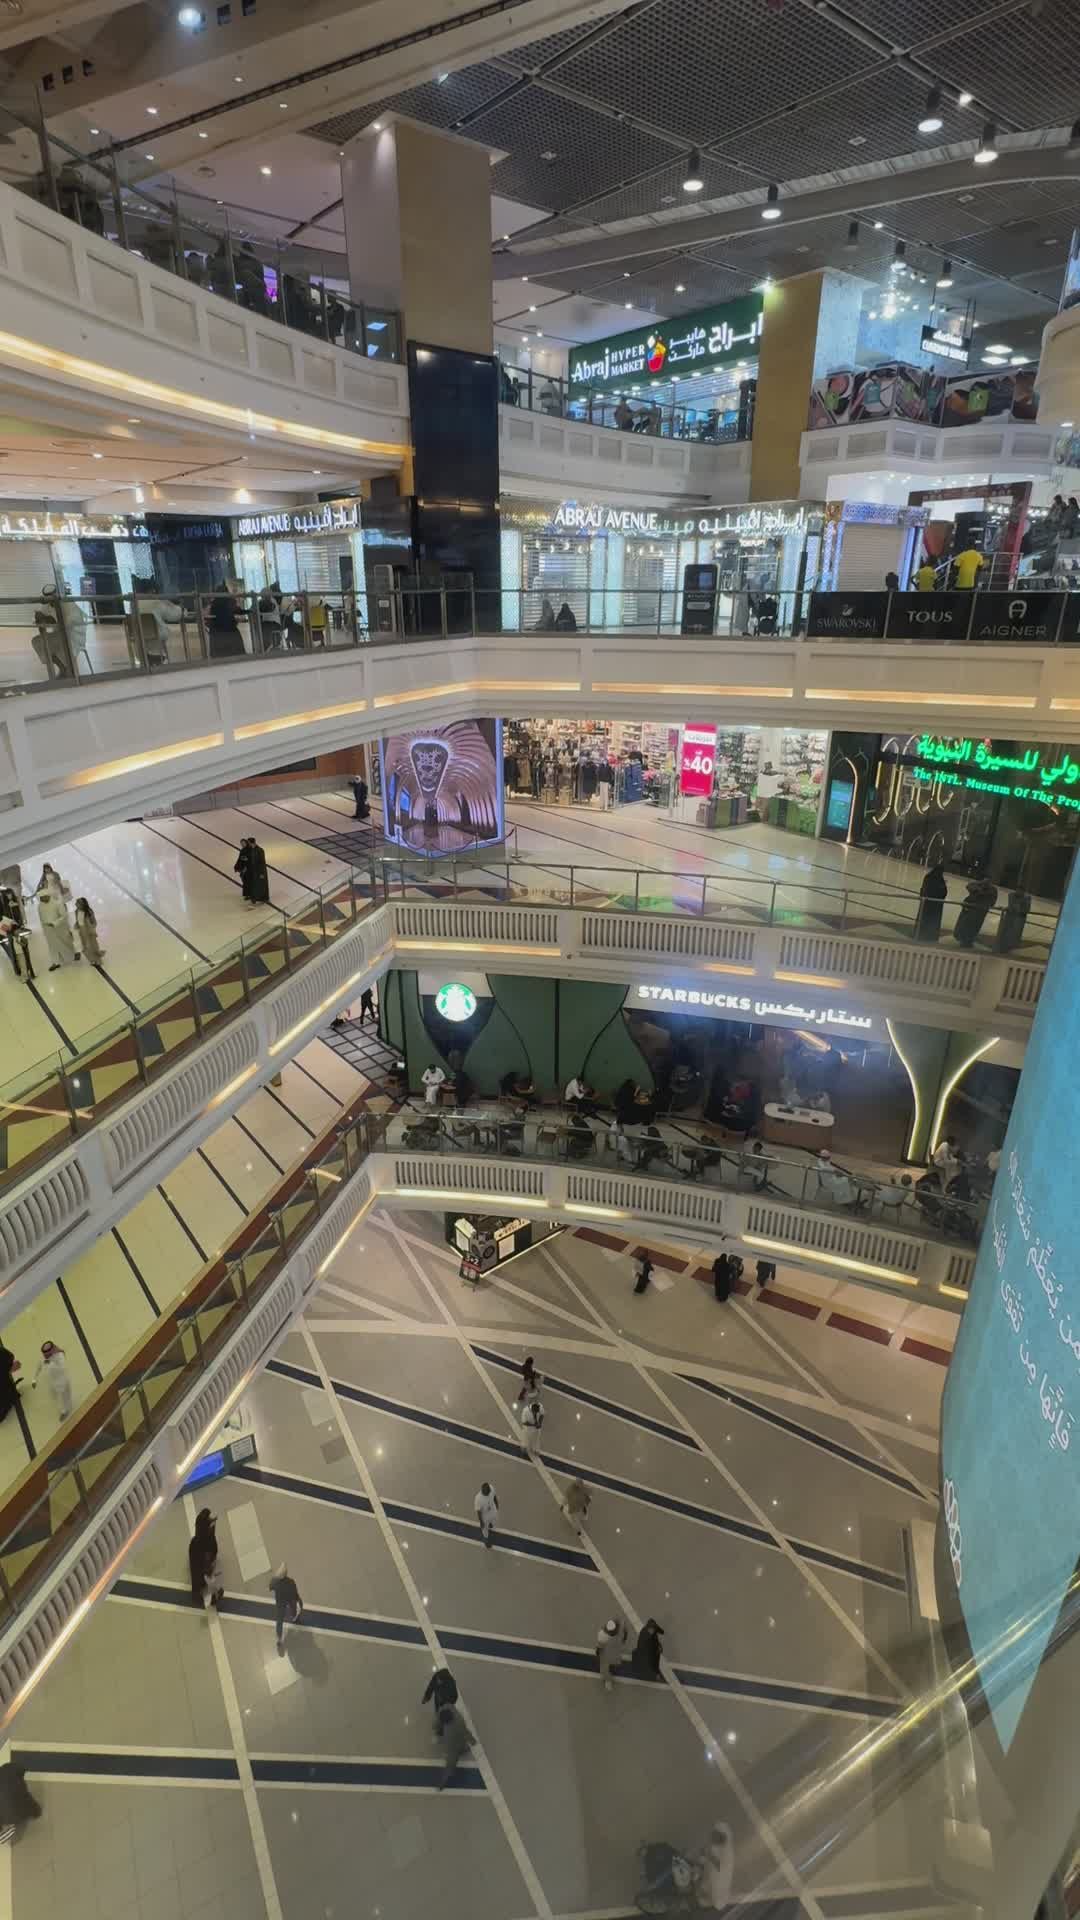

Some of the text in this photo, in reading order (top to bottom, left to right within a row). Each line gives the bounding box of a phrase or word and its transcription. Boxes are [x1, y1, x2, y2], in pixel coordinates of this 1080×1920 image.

[669, 327, 706, 349] هايبر
[611, 343, 645, 363] HYPER
[668, 343, 705, 362] ماركت
[571, 347, 609, 383] Abraj
[611, 358, 645, 377] MARKET
[238, 517, 260, 537] ABRAJ
[261, 512, 290, 533] AVENUE
[554, 507, 605, 528] ABRAJ
[605, 511, 659, 531] AVENUE
[817, 616, 876, 629] SWAROVSKI
[907, 611, 953, 624] TOUS
[980, 625, 1047, 637] AIGNER
[917, 735, 972, 763] النبوية
[975, 742, 1039, 771] للسيرة
[912, 767, 932, 780] The
[965, 777, 1010, 796] Museum
[1014, 786, 1030, 798] Of
[1032, 790, 1054, 803] The
[637, 985, 751, 1011] STARBUCKS
